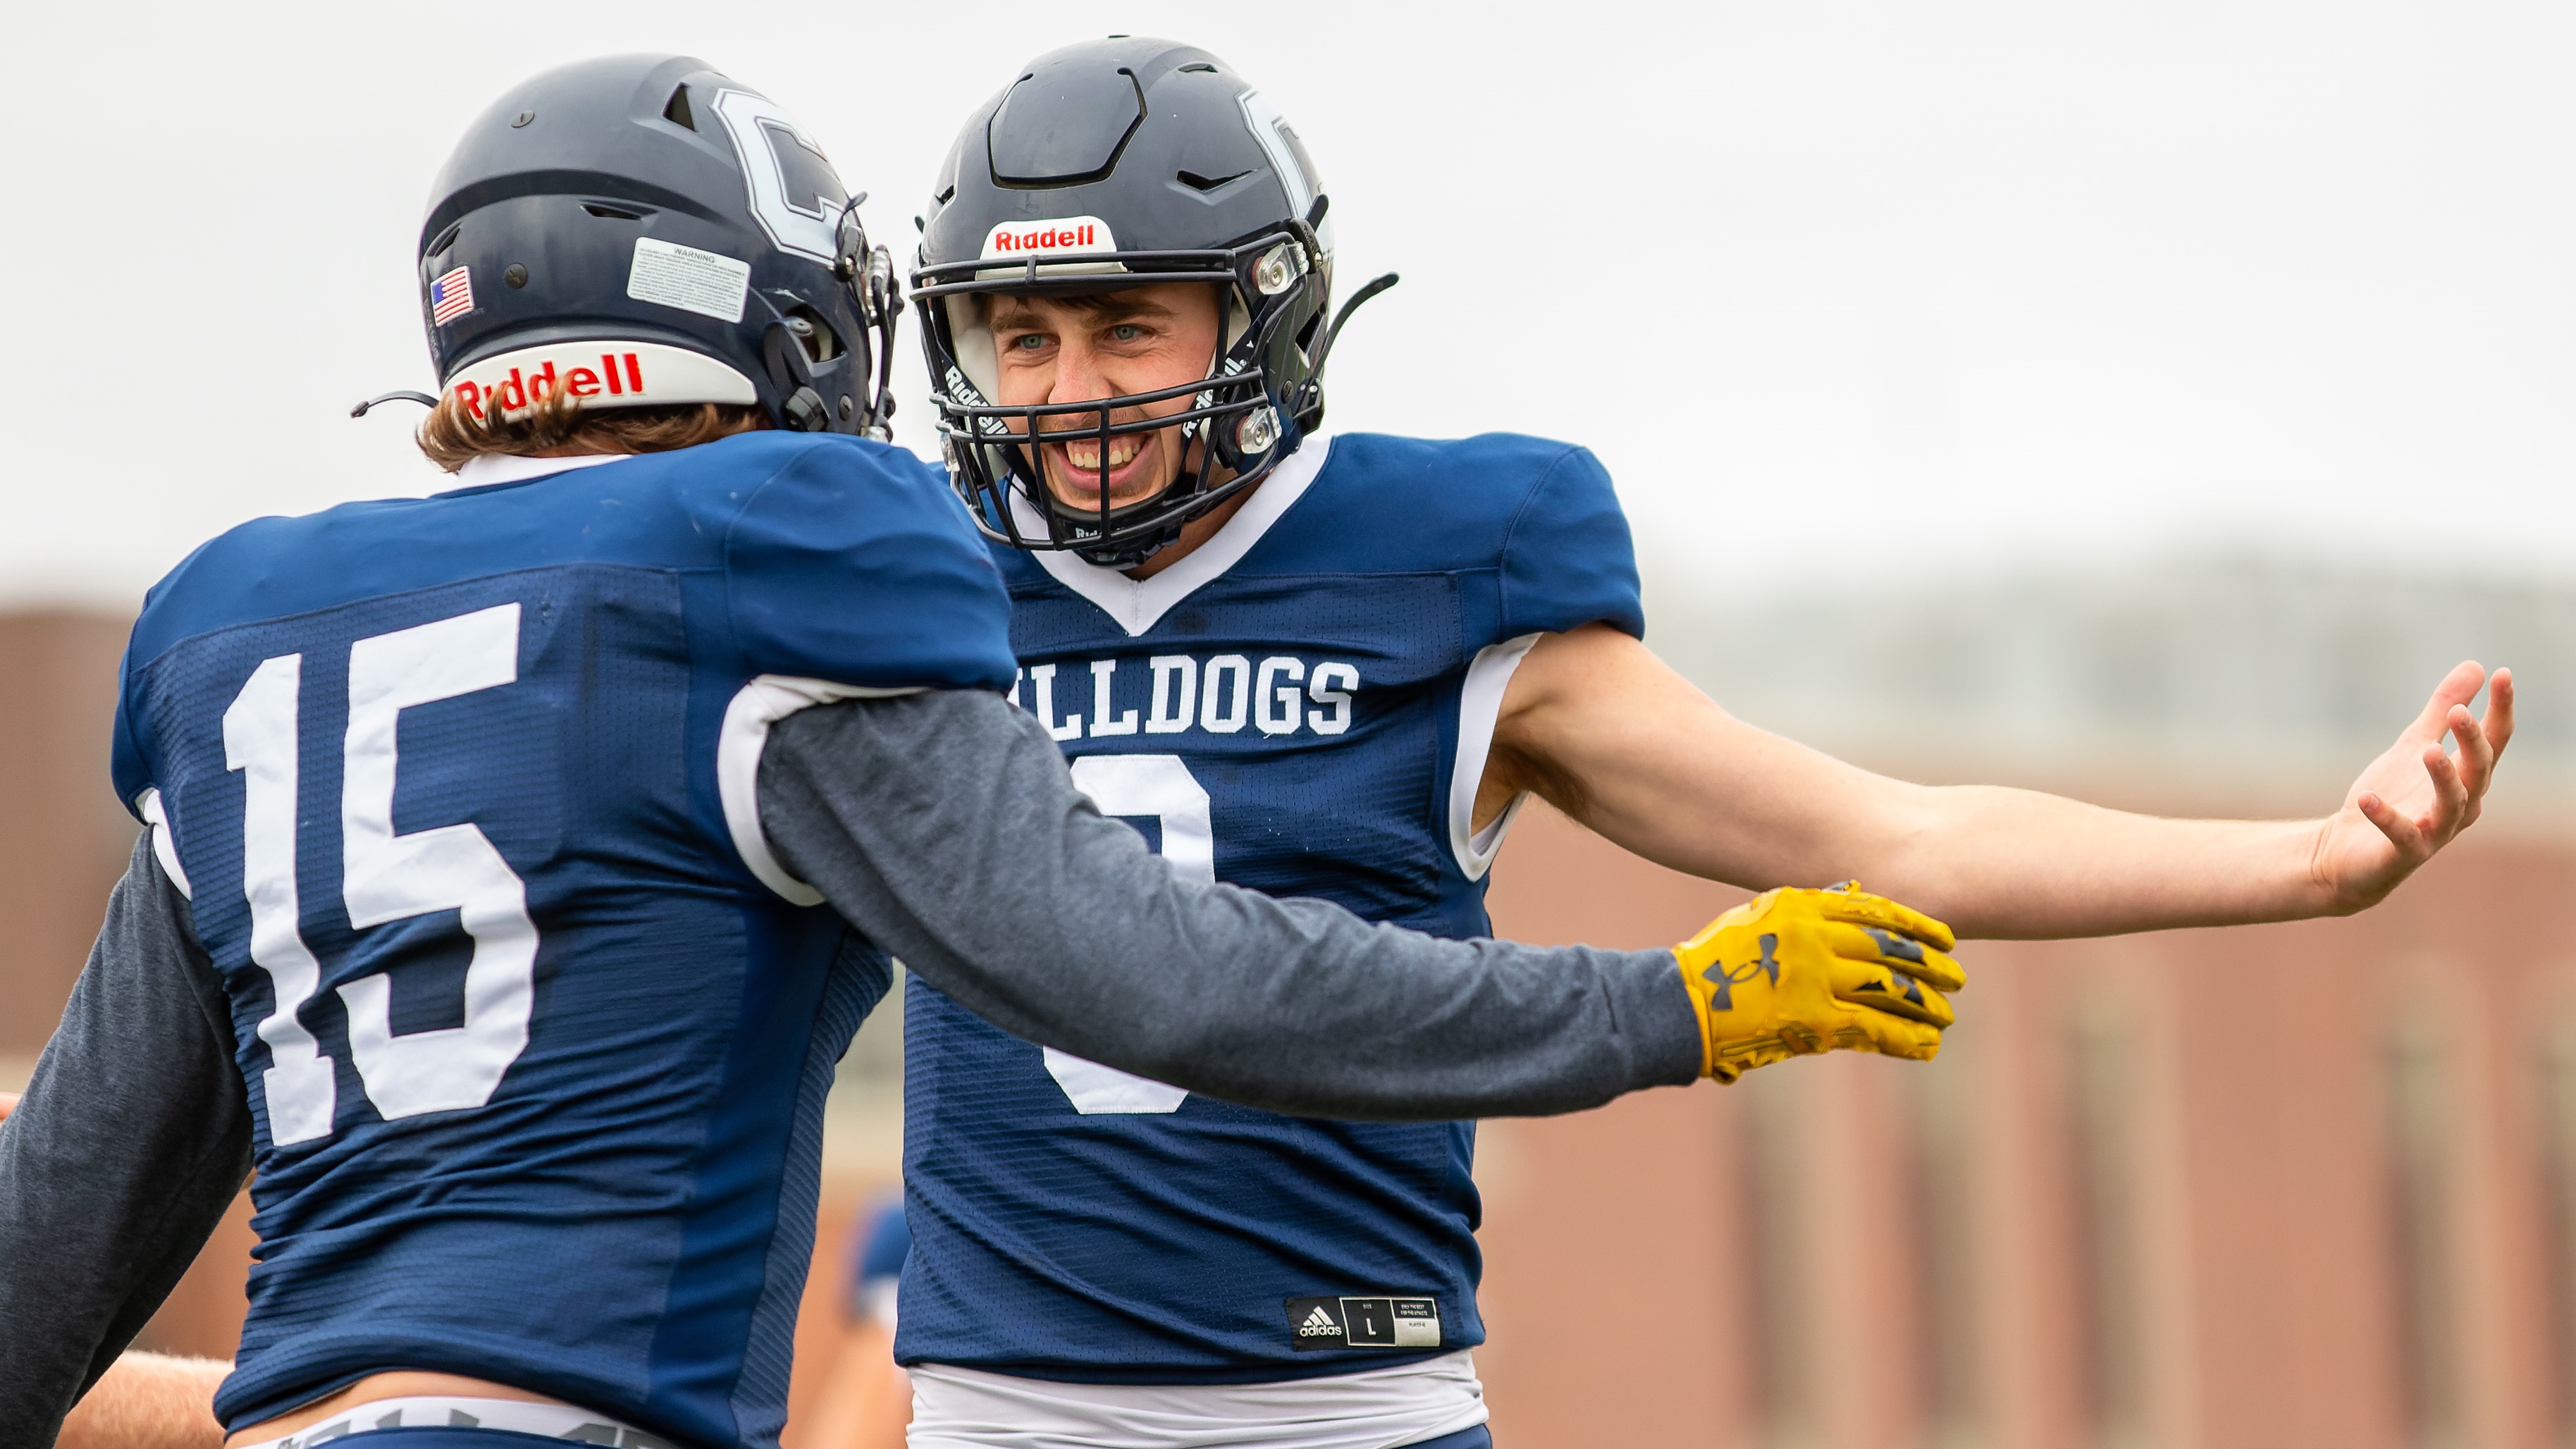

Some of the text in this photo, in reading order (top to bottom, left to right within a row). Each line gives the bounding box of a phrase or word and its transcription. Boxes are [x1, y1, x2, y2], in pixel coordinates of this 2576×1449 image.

[995, 224, 1094, 252] Riddell
[674, 247, 715, 264] WARNING
[222, 602, 540, 1147] 15
[1299, 1324, 1343, 1337] adidas
[1365, 1317, 1376, 1336] L
